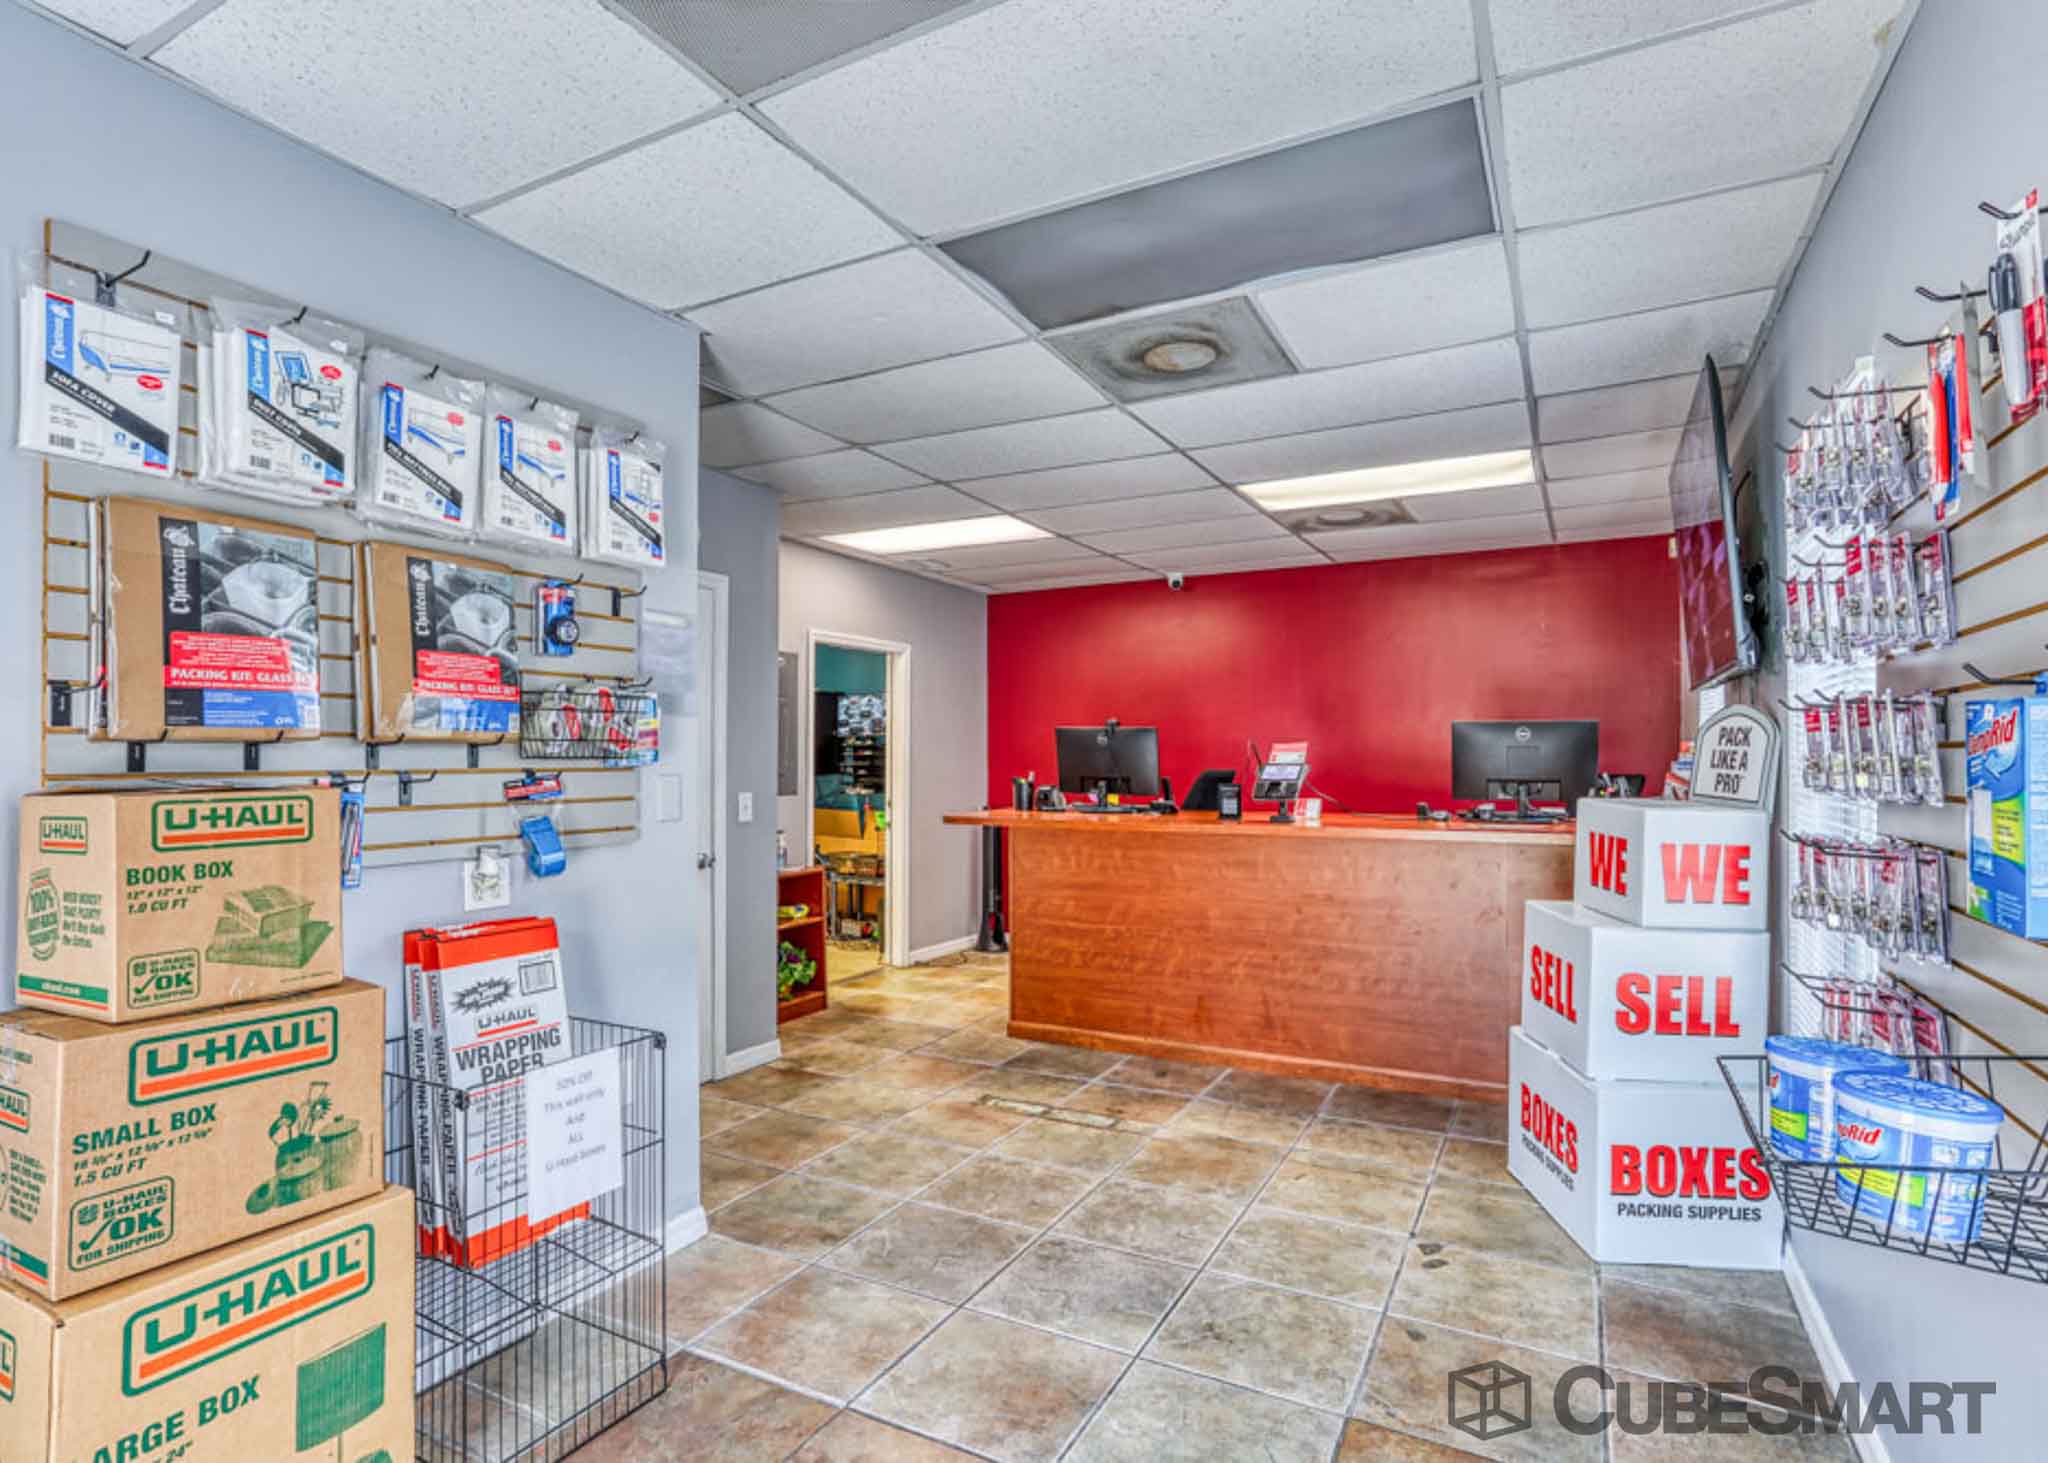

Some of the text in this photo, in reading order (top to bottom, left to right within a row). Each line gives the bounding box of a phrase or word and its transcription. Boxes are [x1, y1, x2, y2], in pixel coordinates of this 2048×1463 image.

[168, 548, 192, 614] Chateau
[414, 582, 430, 637] Chateau
[170, 668, 227, 681] PACKING
[1718, 726, 1753, 748] PACK
[1710, 749, 1748, 771] LIKE A
[1714, 772, 1741, 794] PRO
[165, 804, 303, 830] U-HAUL
[127, 861, 233, 886] BOOK BOX
[1589, 831, 1628, 896] WE
[1660, 842, 1751, 905] WE
[172, 898, 188, 909] FT
[155, 972, 193, 990] OK
[1531, 944, 1578, 1024] SELL
[478, 1008, 537, 1029] U-HAUL
[1615, 972, 1741, 1037] SELL
[146, 1020, 327, 1076] U-HAUL
[456, 1028, 561, 1071] WRAPPING
[481, 1052, 544, 1085] PAPER
[72, 1103, 216, 1155] SMALL BOX
[1520, 1081, 1578, 1174] BOXES
[74, 1158, 147, 1187] 1.5 CU FT
[1610, 1144, 1771, 1200] BOXES
[103, 1184, 167, 1209] U-HAUL
[103, 1195, 167, 1219] BOXES
[1617, 1203, 1762, 1222] PACKING SUPPLIES
[110, 1207, 163, 1240] OK
[107, 1231, 165, 1255] SHIPPING
[144, 1244, 361, 1354] U-HAUL
[88, 1374, 260, 1463] ARGE BOX
